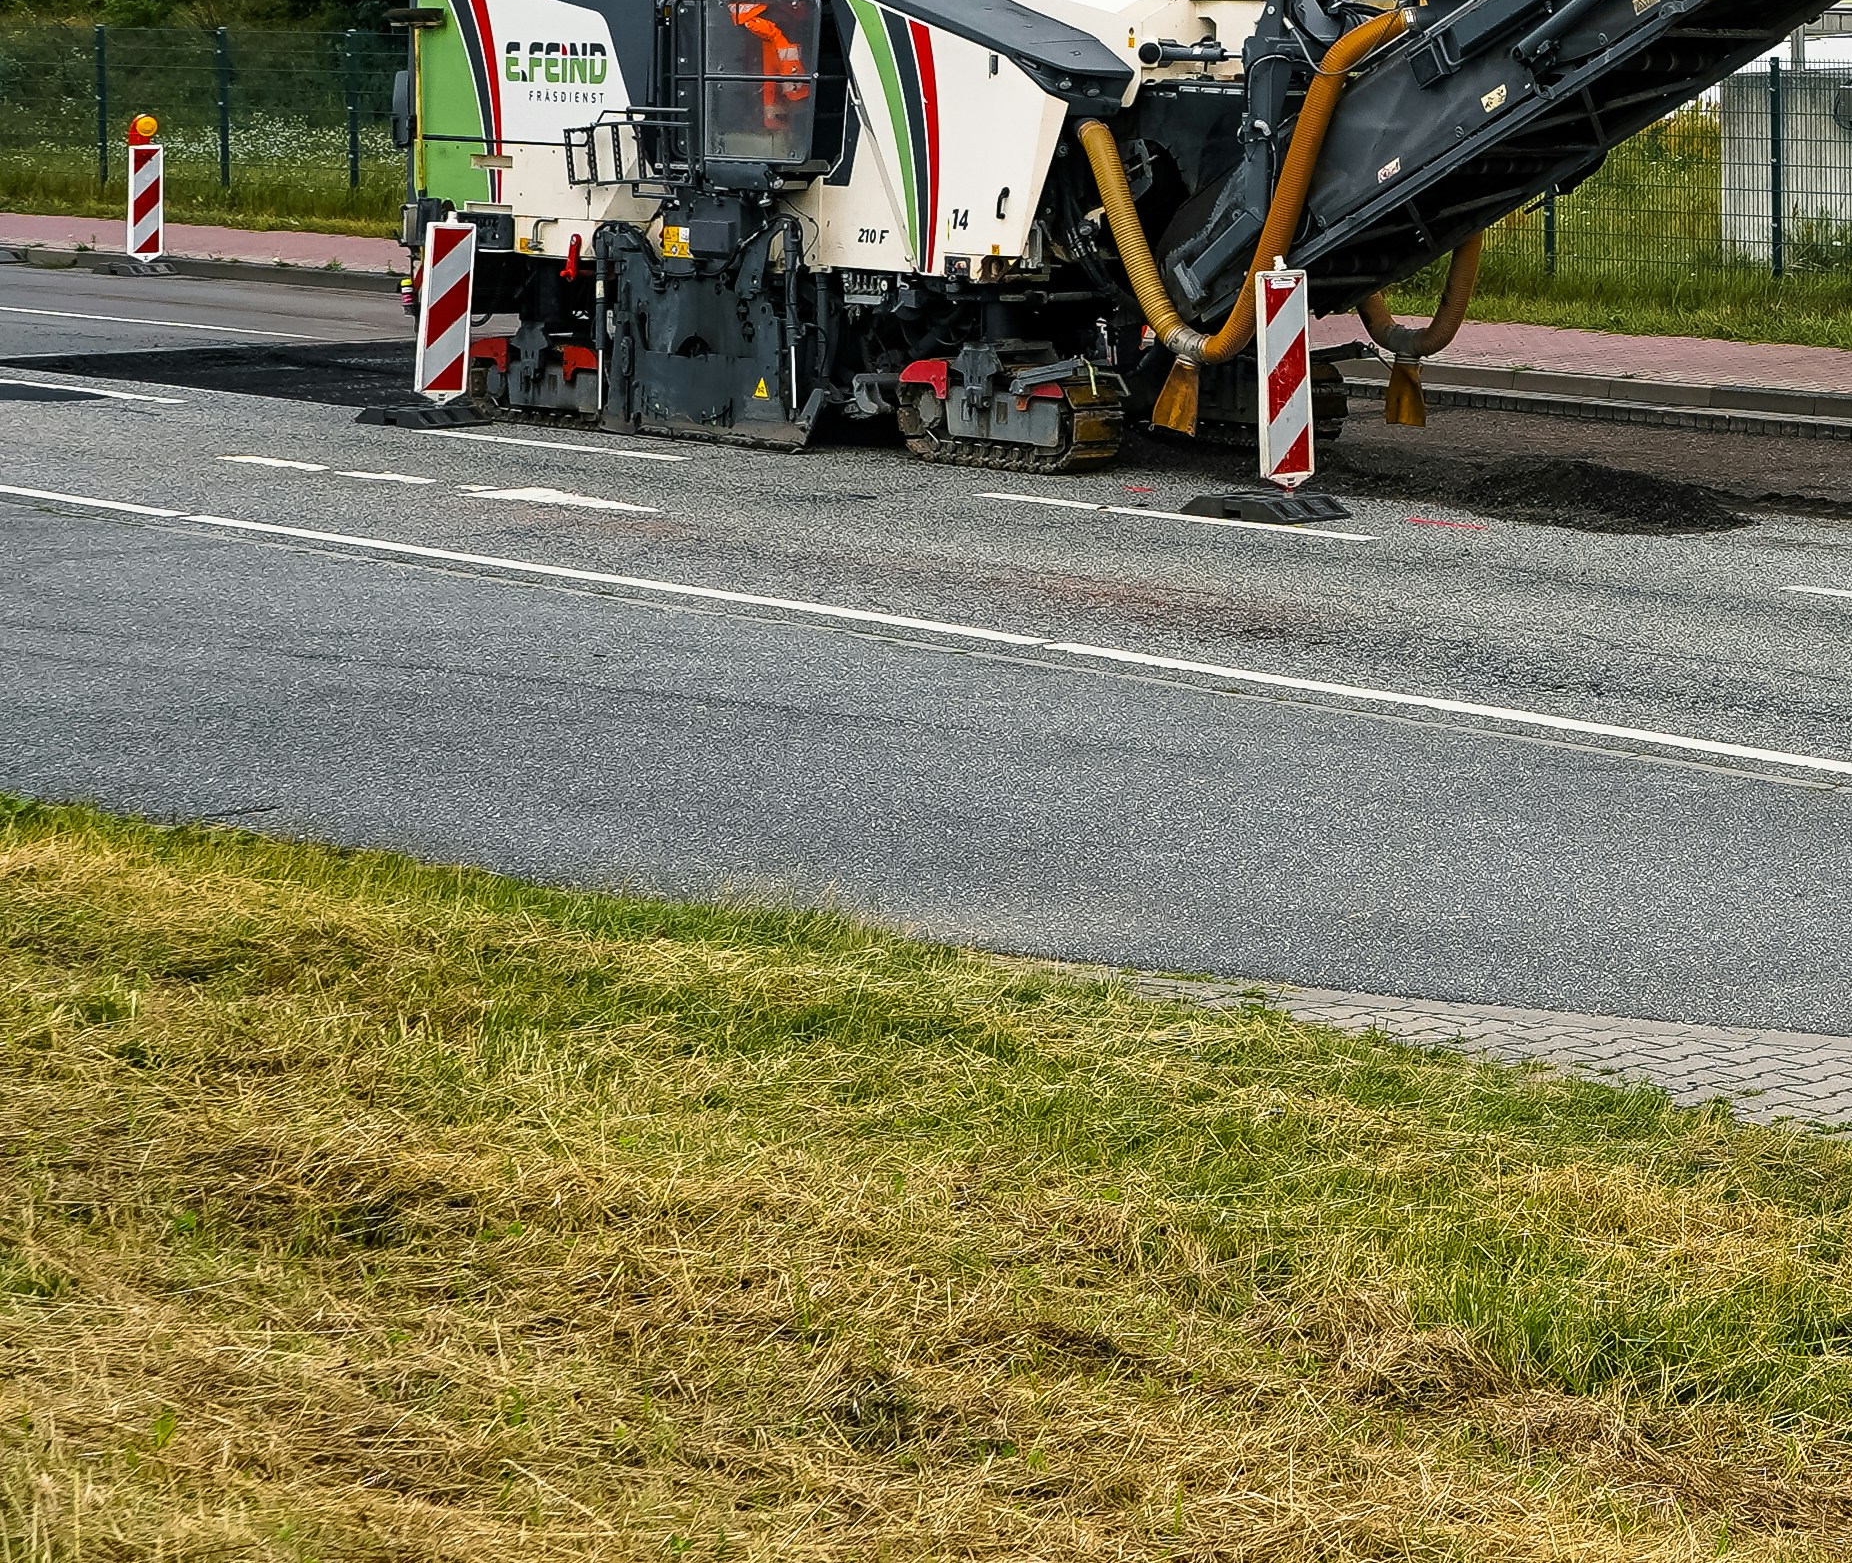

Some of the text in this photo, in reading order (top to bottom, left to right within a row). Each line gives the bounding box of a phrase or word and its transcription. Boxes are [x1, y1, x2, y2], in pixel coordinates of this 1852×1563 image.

[505, 41, 607, 84] E.FEIND
[528, 89, 605, 104] FRÄSDIENST
[952, 208, 969, 231] 14
[857, 228, 890, 245] 210 F
